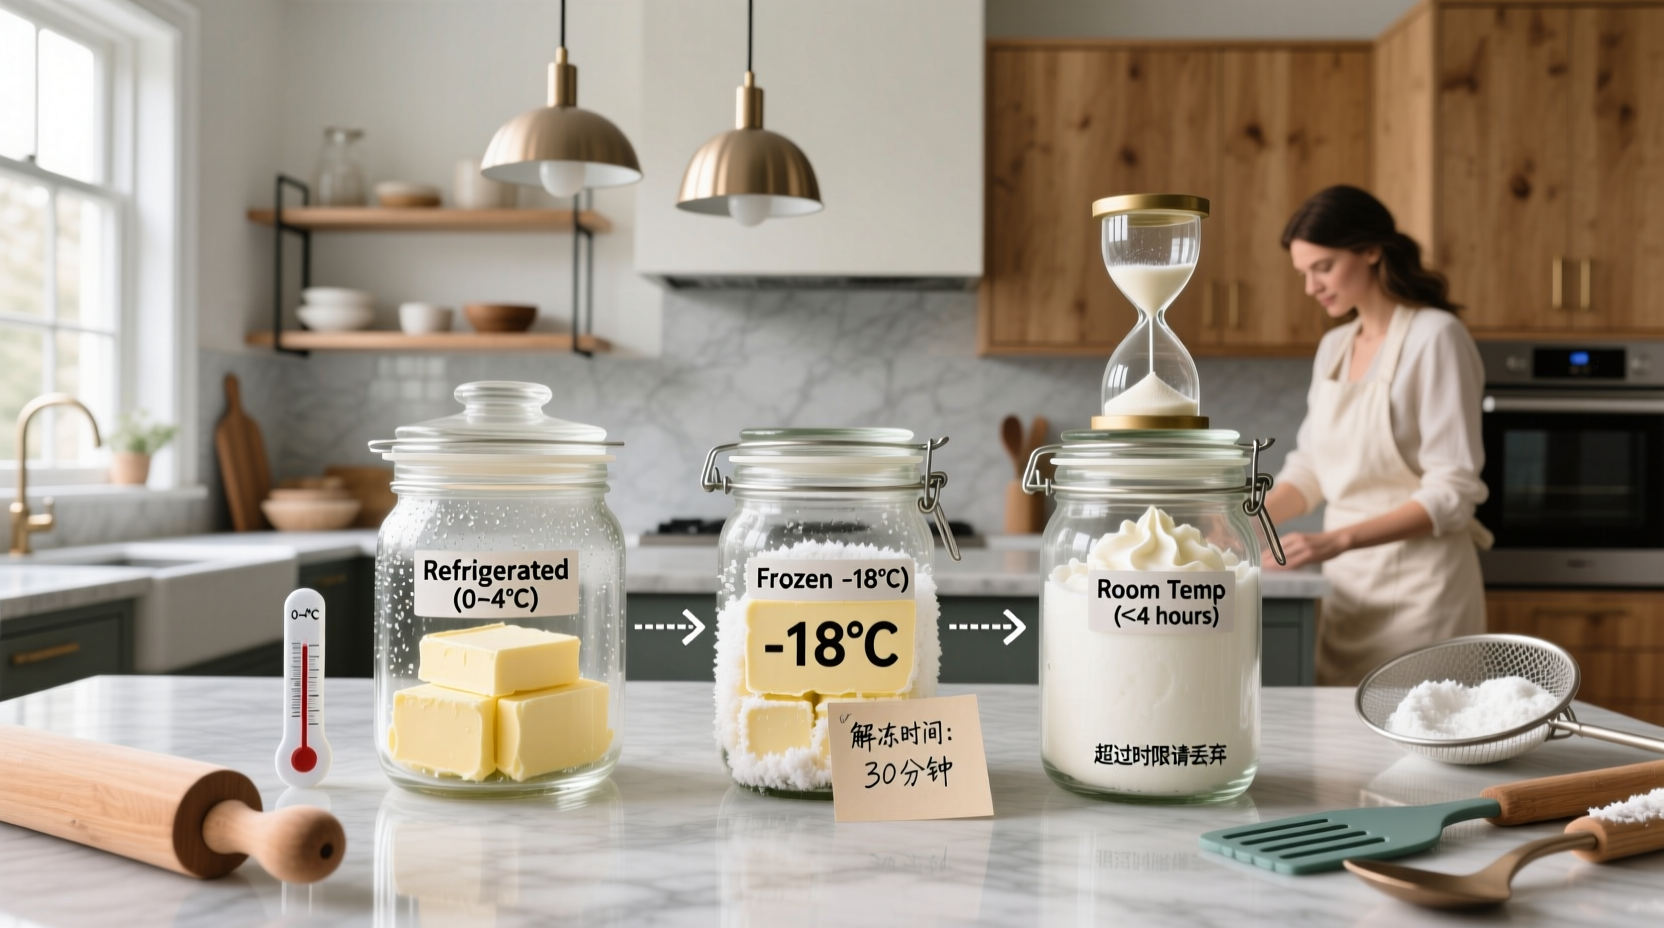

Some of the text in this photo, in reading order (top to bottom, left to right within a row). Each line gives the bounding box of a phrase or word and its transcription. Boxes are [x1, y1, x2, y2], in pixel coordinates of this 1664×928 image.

[425, 557, 569, 586] Refrigerated
[758, 567, 832, 590] Frozen
[1097, 578, 1226, 605] Room Temp
[1114, 605, 1220, 628] (<4 hours)
[765, 621, 899, 667] -18°C
[1094, 743, 1228, 768] 超过时限请丢弃
[865, 755, 953, 789] 30分钟
